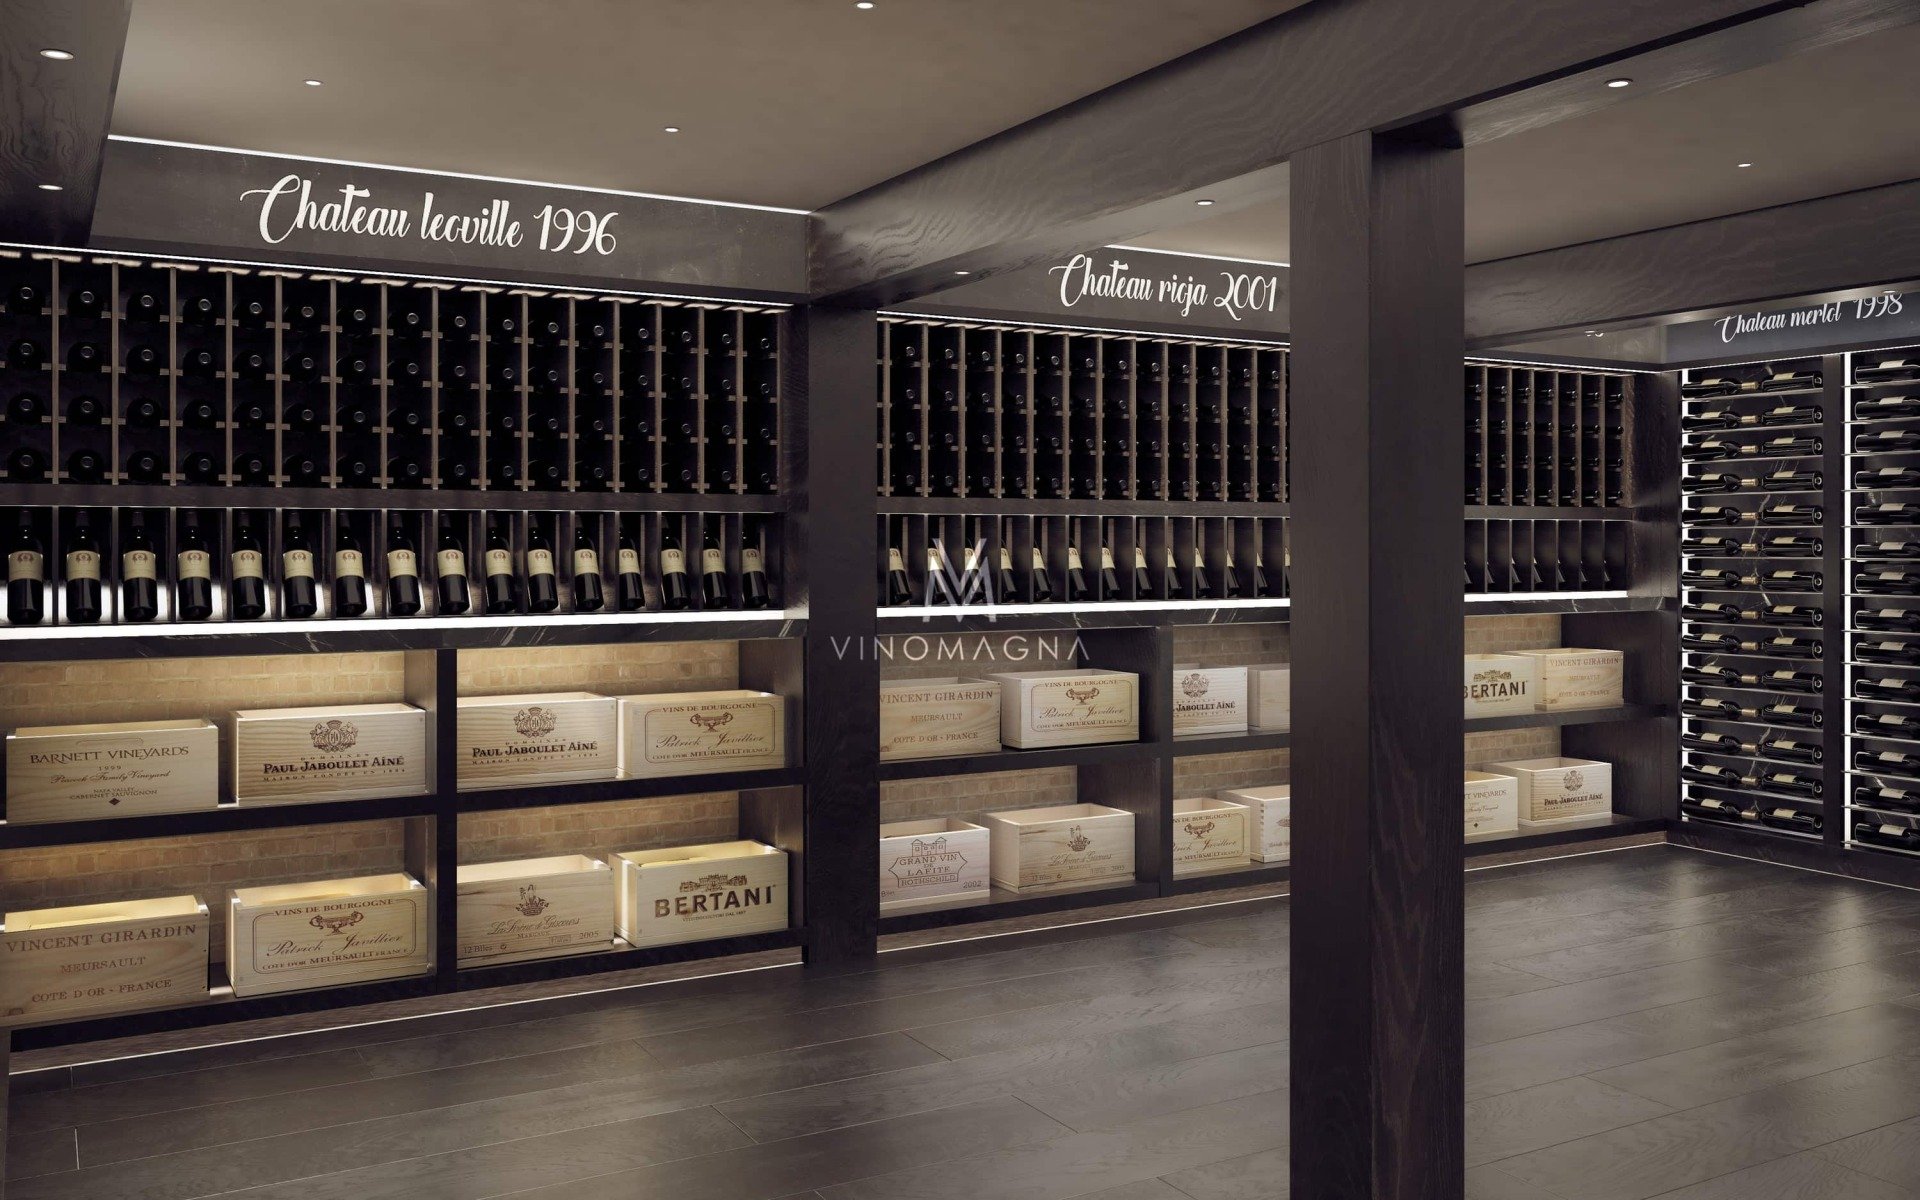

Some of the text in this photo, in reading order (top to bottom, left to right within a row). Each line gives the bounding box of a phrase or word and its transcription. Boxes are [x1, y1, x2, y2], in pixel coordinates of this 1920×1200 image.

[240, 173, 411, 244] Chateau
[533, 205, 619, 255] 1996
[1048, 253, 1277, 321] Chateau rioja 2001
[1550, 658, 1581, 667] VINCENT
[1464, 681, 1526, 698] BERTANI
[880, 691, 993, 704] VINCENT GIRARDIN
[661, 705, 684, 713] VINS
[700, 702, 757, 711] BOURGOGNE
[1175, 703, 1214, 711] JABOULET
[656, 734, 701, 748] Patrick
[946, 732, 978, 741] FRANCE
[30, 745, 189, 765] BARNETT VINEYARDS
[472, 747, 503, 758] PAUL
[505, 744, 566, 755] JABOULET
[690, 749, 740, 758] MEURSAULT
[263, 763, 298, 774] PAUL
[300, 760, 369, 772] JABOULET
[90, 771, 128, 783] Family
[128, 769, 171, 780] Vineyard
[263, 774, 306, 783] MAISON
[69, 789, 158, 800] CABERNET SAUVIGNON
[899, 853, 958, 866] GRAND VIN
[907, 866, 951, 876] LAFITE
[901, 874, 956, 886] ROTHSCHILD
[963, 880, 982, 889] 2002
[274, 898, 394, 917] VINS DE BOURGOGNE
[654, 885, 772, 918] BERTANI
[6, 924, 196, 952] VINCENT GIRARDIN
[266, 939, 324, 957] Patrick
[309, 950, 374, 964] MEURSAULT
[60, 956, 147, 974] MEURSAULT
[32, 990, 67, 1003] COTE
[118, 979, 172, 994] FRANCE
